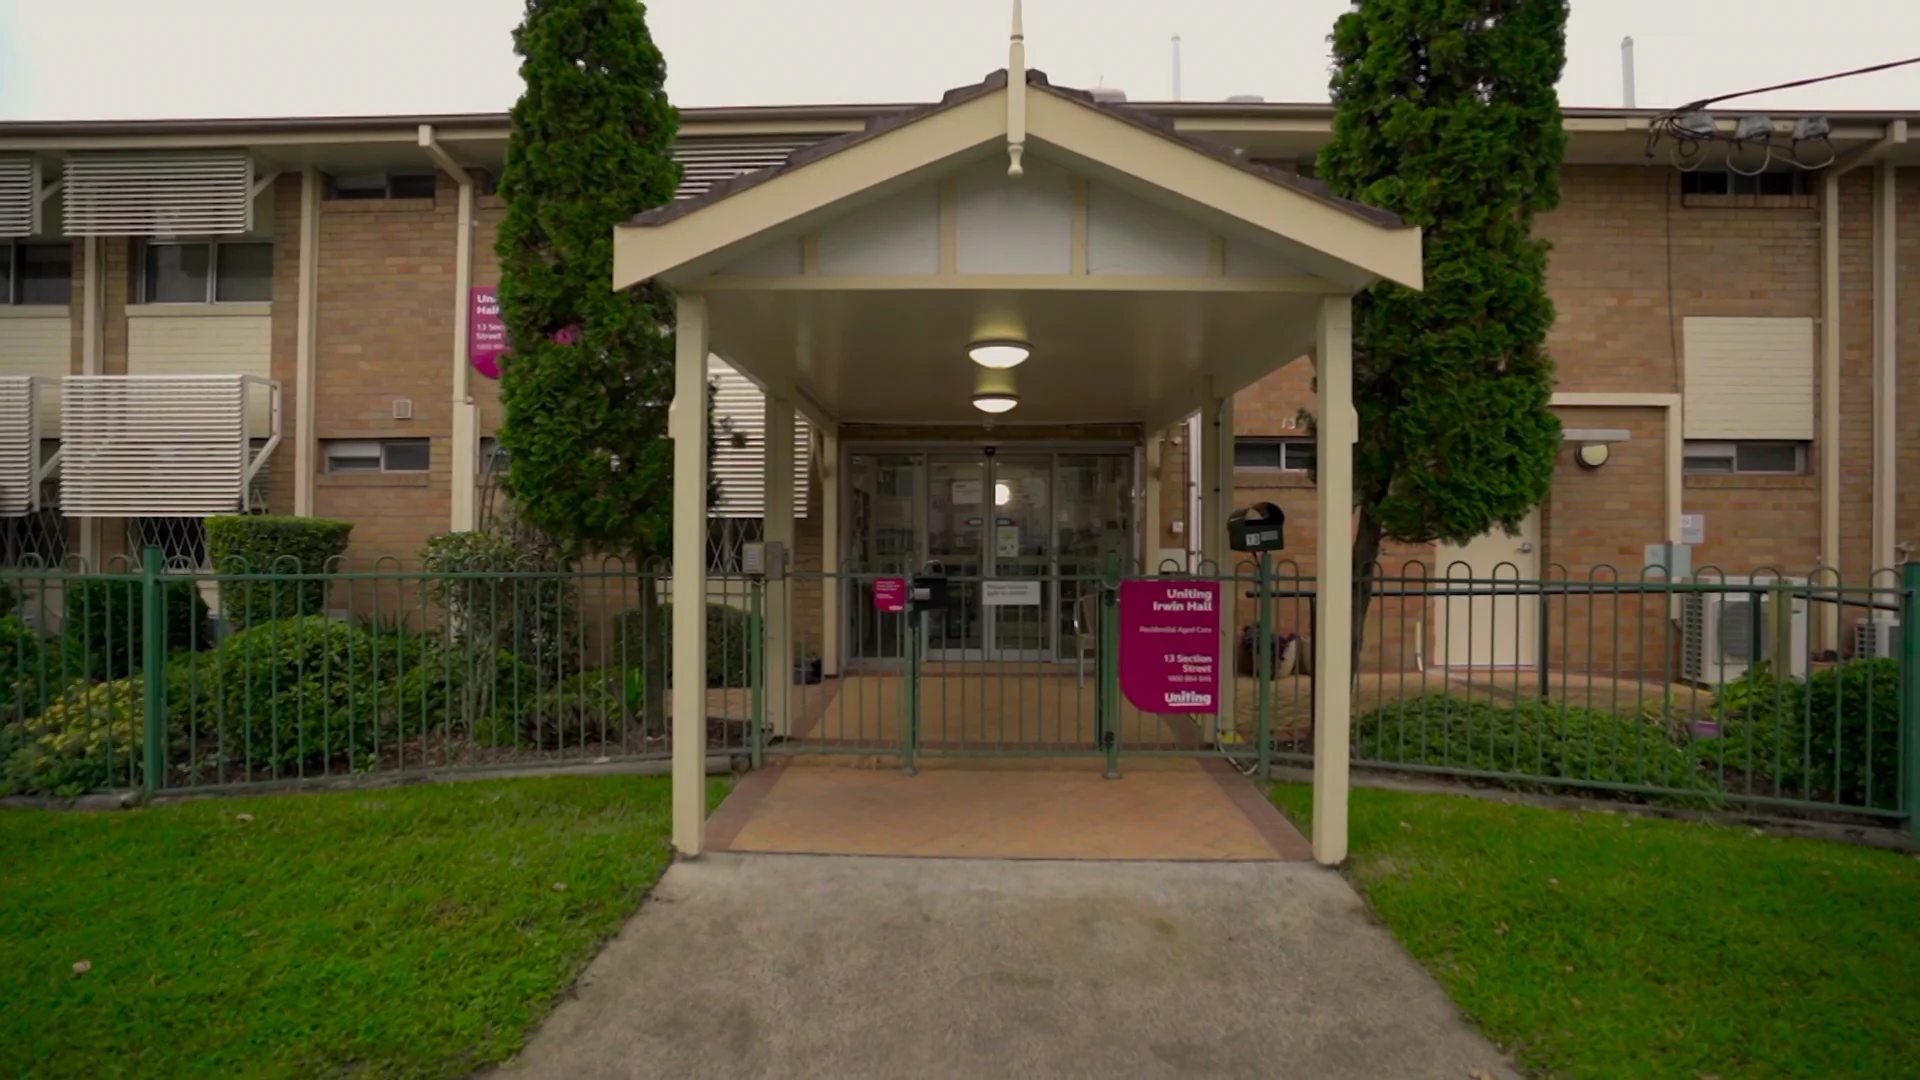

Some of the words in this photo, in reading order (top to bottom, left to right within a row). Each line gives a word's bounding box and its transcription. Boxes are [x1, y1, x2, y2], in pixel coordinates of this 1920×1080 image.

[477, 323, 487, 331] 13
[476, 332, 502, 341] Street
[1166, 588, 1213, 602] Uniting
[1153, 601, 1184, 611] Irwin
[1186, 601, 1213, 611] Hall
[1139, 625, 1177, 633] Residential
[1178, 626, 1195, 634] Aged
[1164, 654, 1175, 663] 13
[1176, 654, 1213, 663] Section
[1182, 664, 1212, 673] Street
[1164, 690, 1212, 707] Uniting
